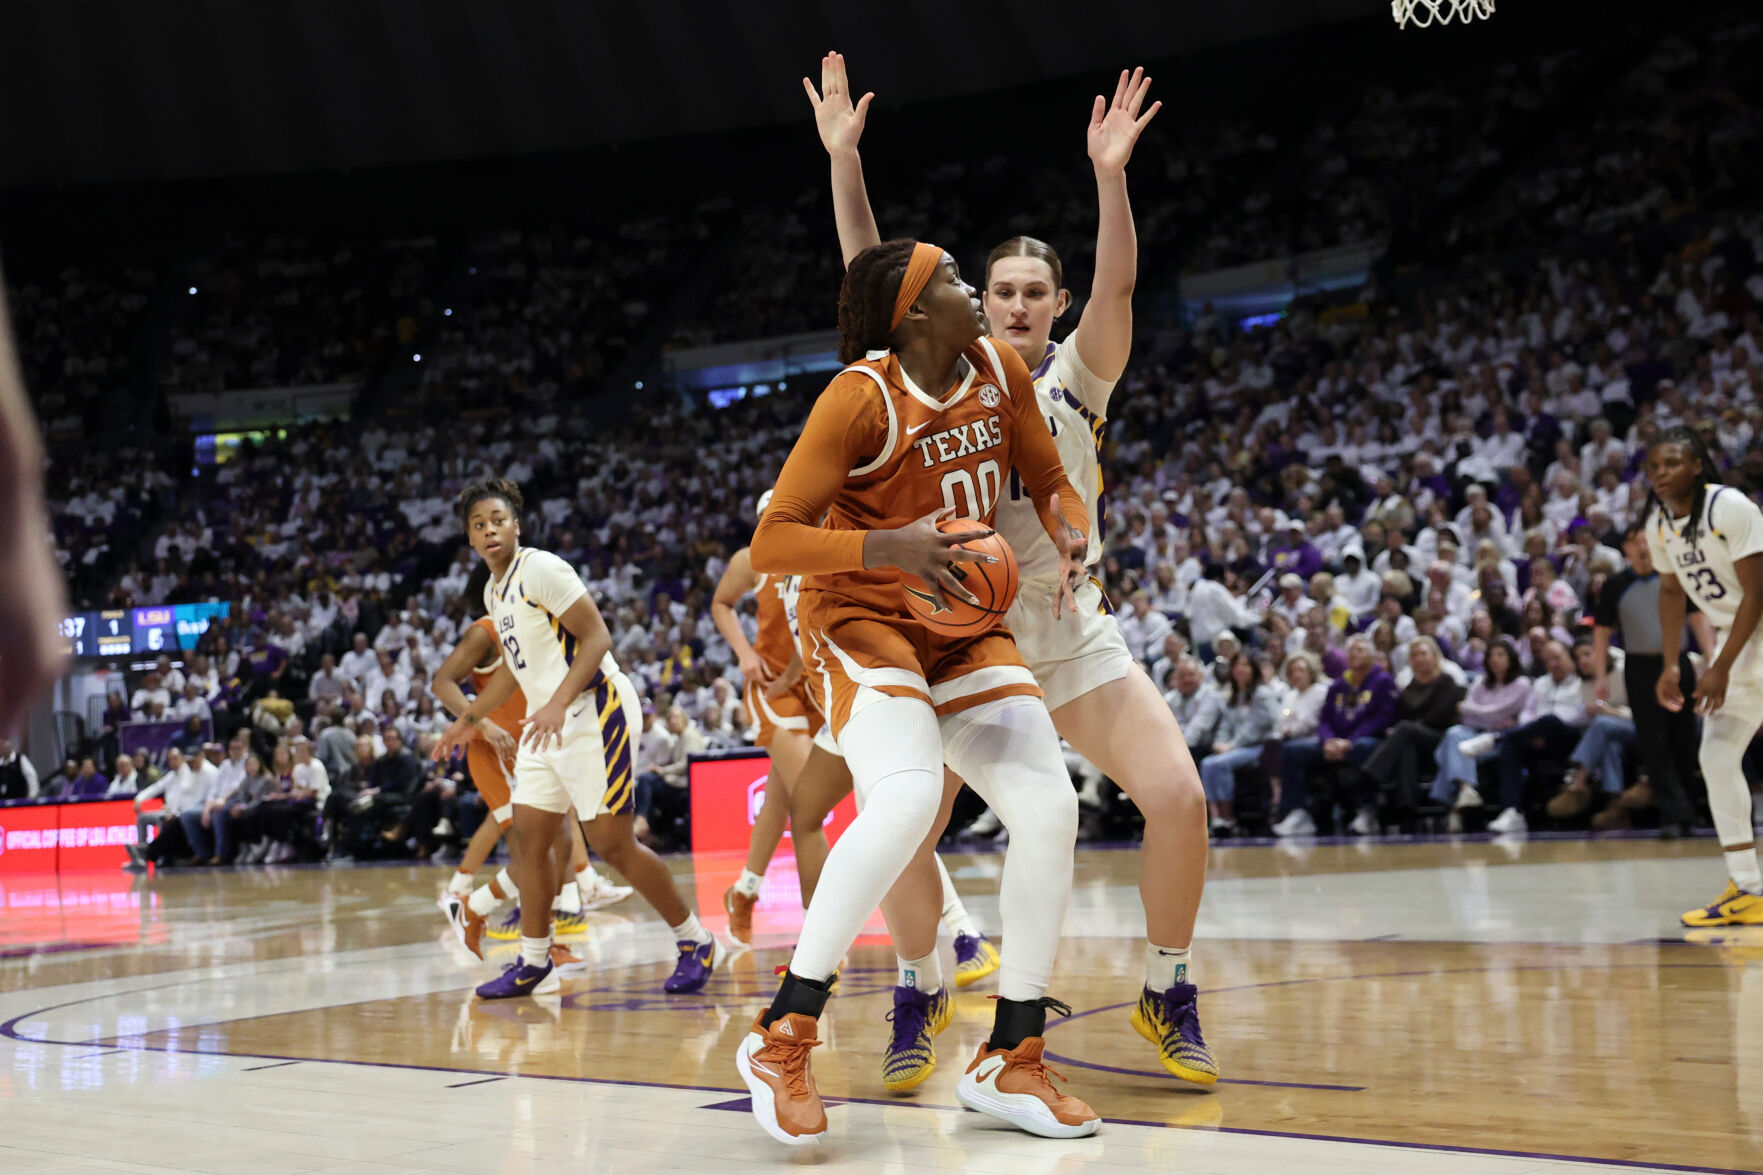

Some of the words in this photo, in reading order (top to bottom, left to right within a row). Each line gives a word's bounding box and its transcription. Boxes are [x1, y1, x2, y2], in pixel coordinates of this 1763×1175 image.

[979, 384, 1000, 408] SEC
[914, 415, 1002, 468] TEXAS
[940, 459, 1001, 521] 00
[1677, 550, 1705, 567] LSU
[1686, 568, 1726, 600] 23
[109, 619, 119, 635] 1
[137, 610, 170, 625] LSU
[500, 614, 514, 633] LSU
[504, 635, 526, 670] 12
